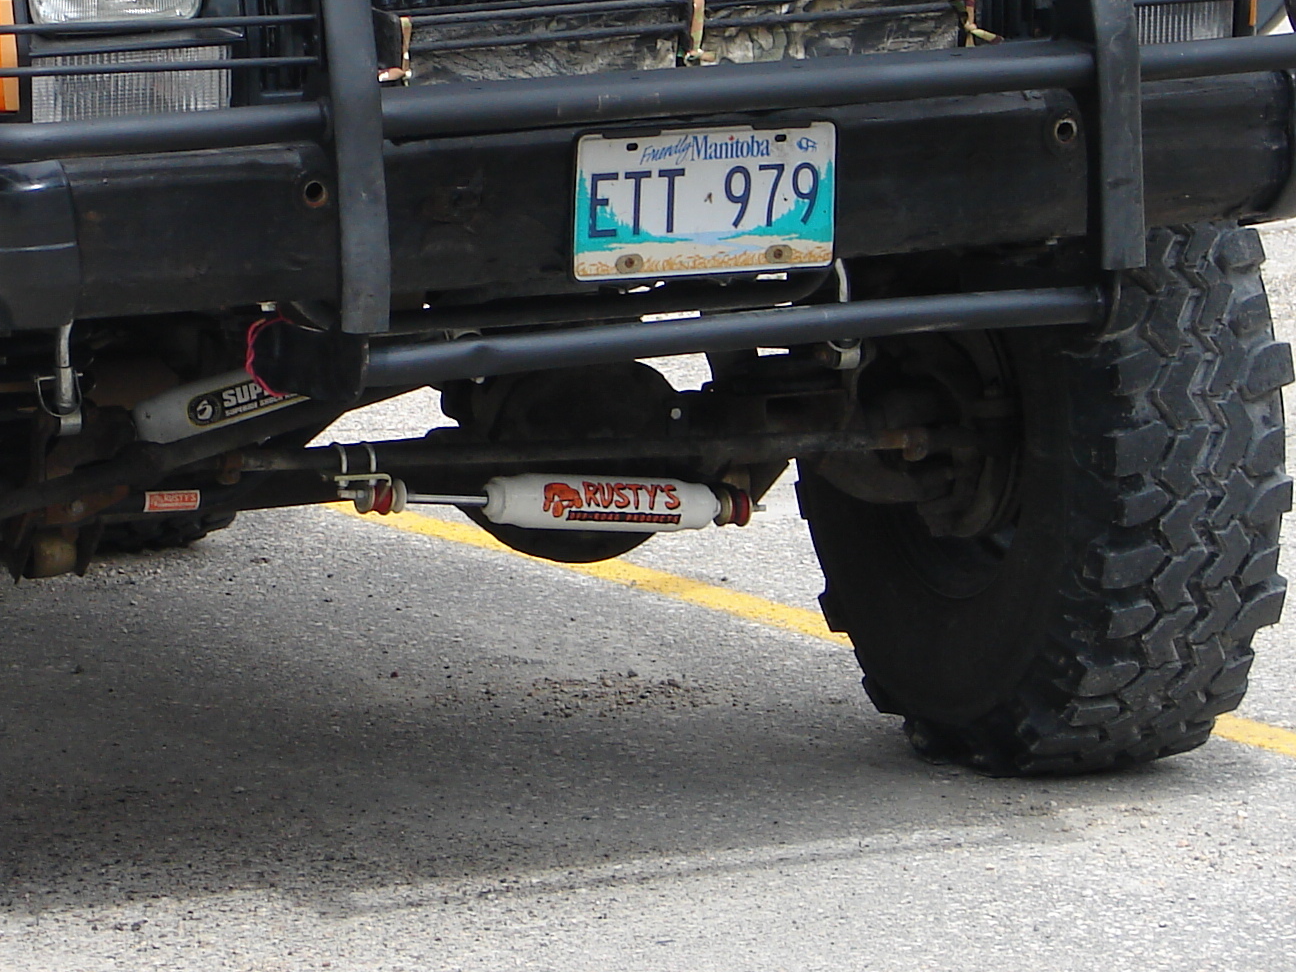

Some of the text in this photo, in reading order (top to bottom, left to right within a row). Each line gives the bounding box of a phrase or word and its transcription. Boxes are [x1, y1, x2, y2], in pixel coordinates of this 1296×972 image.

[690, 134, 771, 161] Manitoba
[588, 162, 820, 239] ETT 979
[582, 481, 681, 510] RUSTY'S
